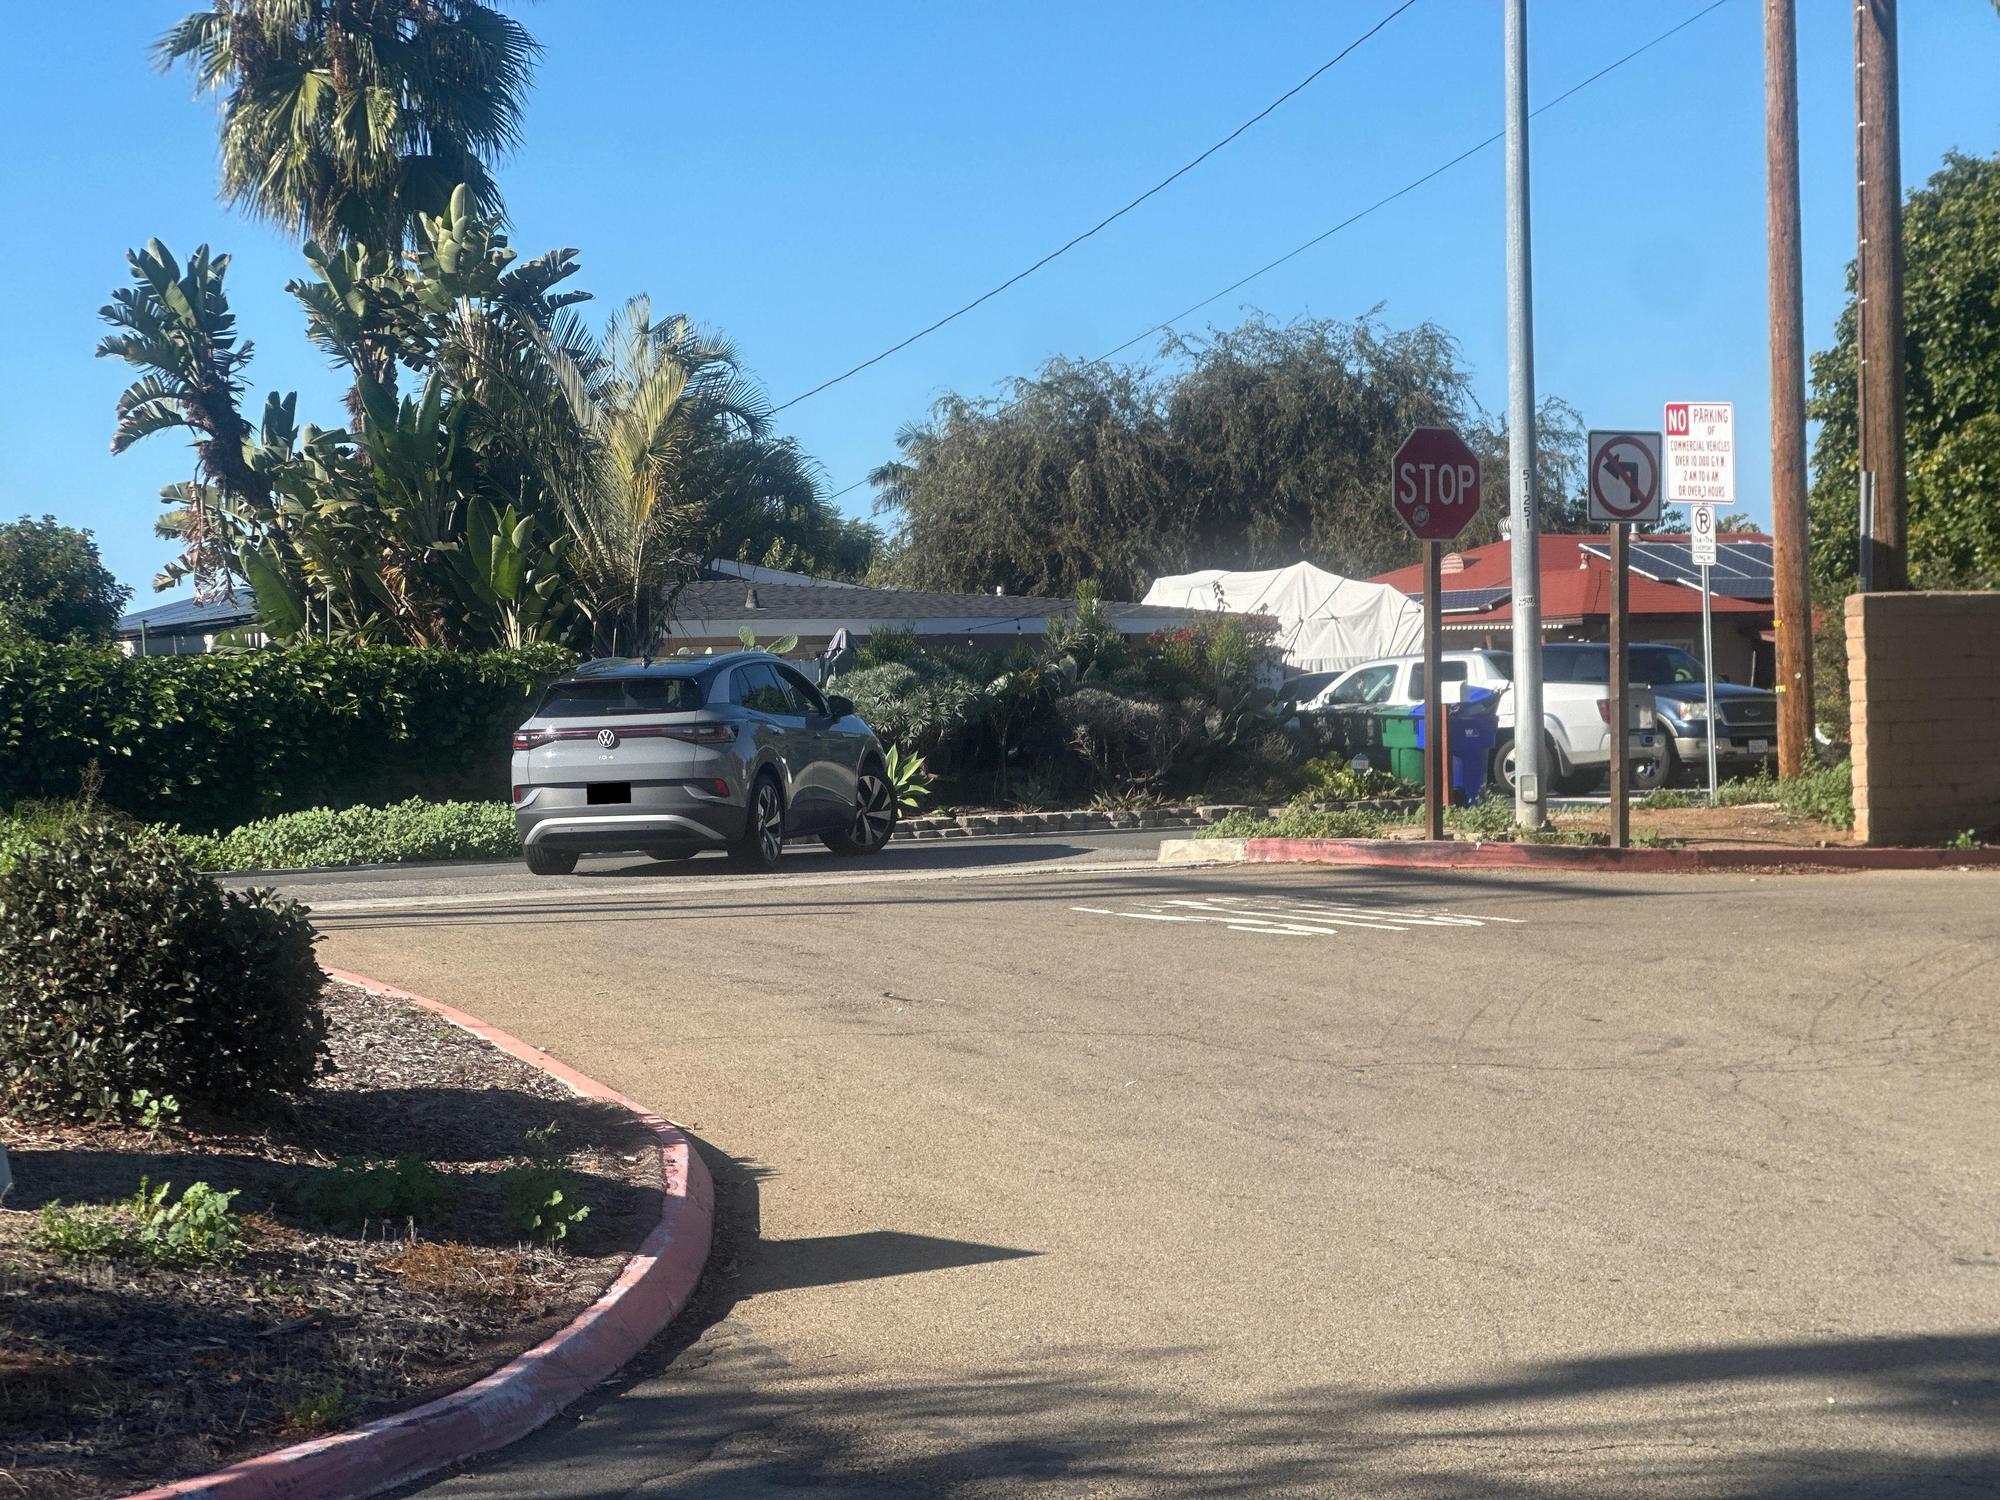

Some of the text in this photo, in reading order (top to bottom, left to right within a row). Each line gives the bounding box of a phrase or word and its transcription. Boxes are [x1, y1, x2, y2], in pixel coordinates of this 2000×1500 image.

[1668, 408, 1728, 432] NO PARKING
[1708, 425, 1715, 436] OF
[1670, 440, 1730, 452] COMMERCIAL VEHICLES
[1676, 456, 1690, 466] OVER
[1684, 470, 1688, 482] 2
[1689, 470, 1696, 482] AM
[1698, 470, 1705, 482] TO
[1712, 471, 1720, 482] AM
[1400, 462, 1476, 505] STOP
[1678, 485, 1686, 496] OR
[1688, 485, 1702, 496] OVER
[1708, 486, 1725, 498] HOURS
